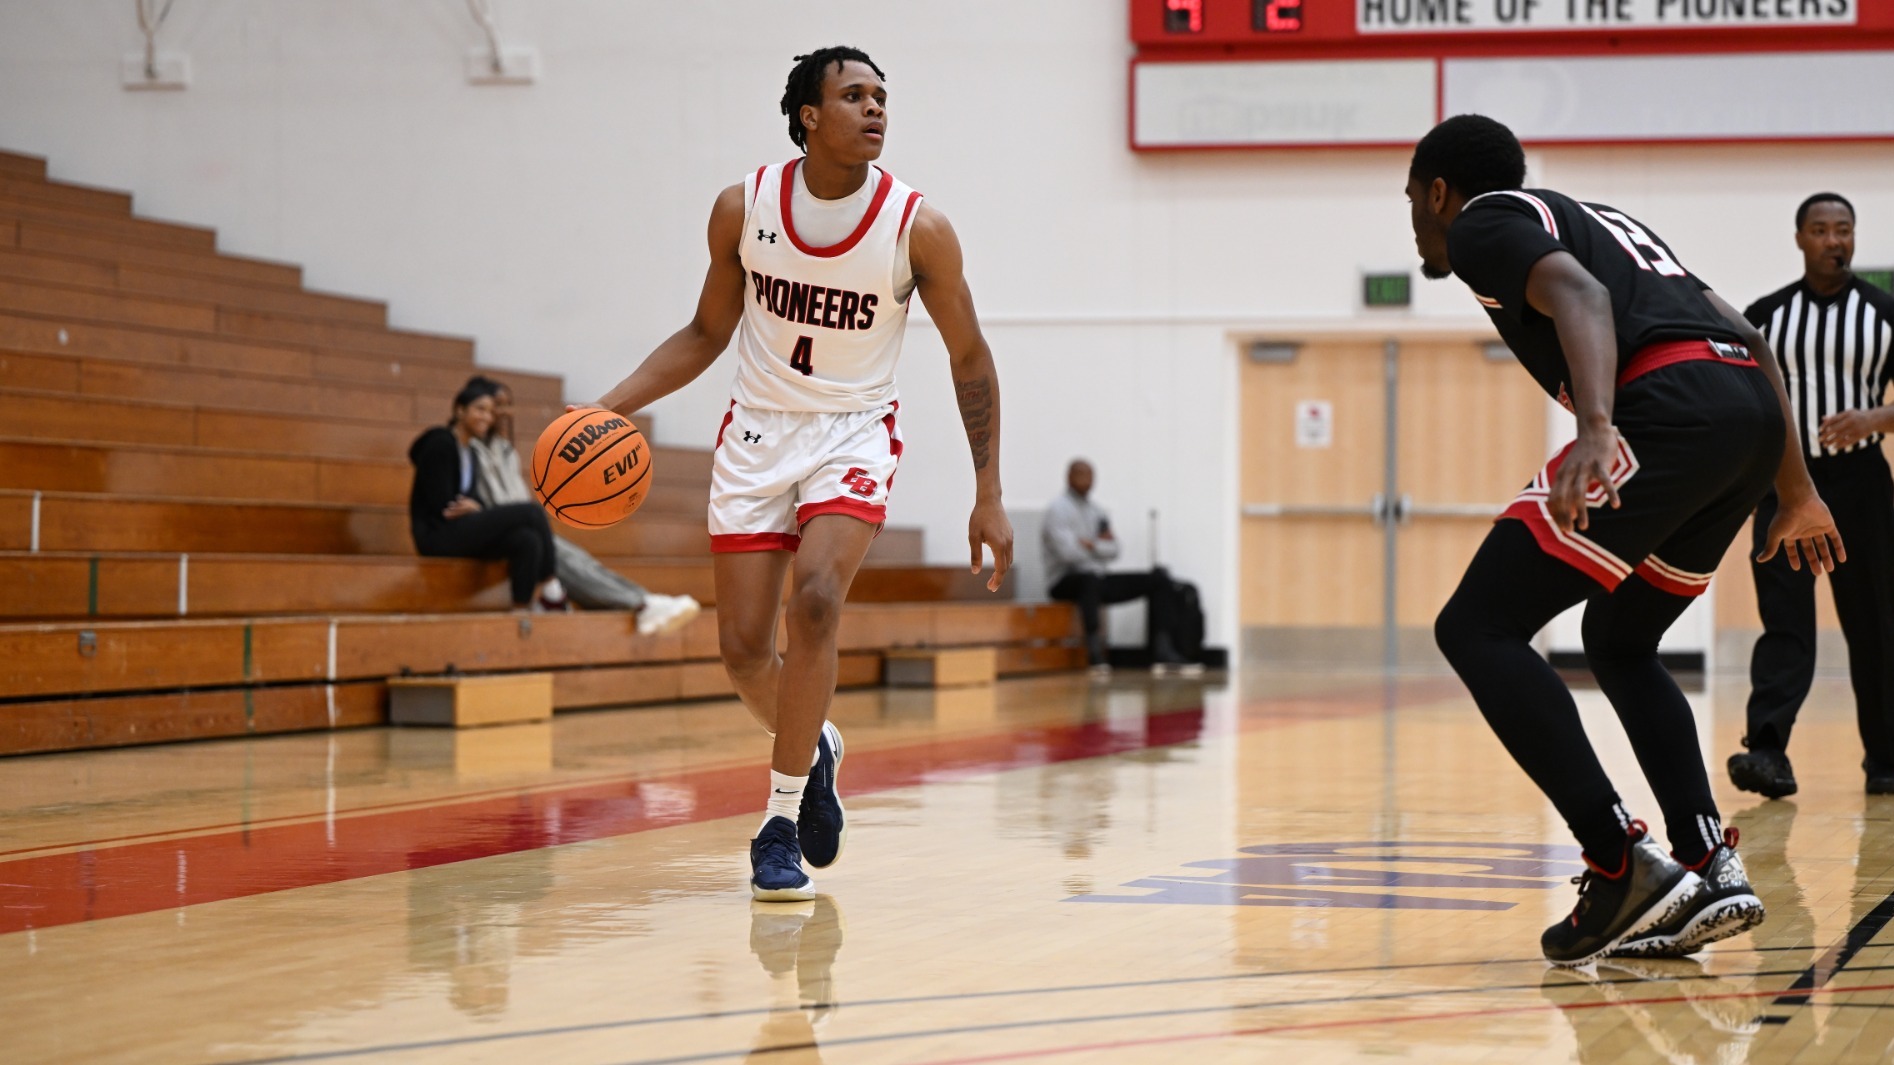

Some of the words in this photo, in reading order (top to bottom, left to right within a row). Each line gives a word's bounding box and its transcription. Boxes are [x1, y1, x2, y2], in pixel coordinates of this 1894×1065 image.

[1364, 0, 1472, 24] HOME
[1494, 0, 1541, 22] OF
[1657, 0, 1848, 20] PIONEERS
[1578, 202, 1687, 276] 13
[751, 270, 878, 330] PIONEERS
[790, 335, 813, 376] 4
[558, 417, 629, 463] Wilson
